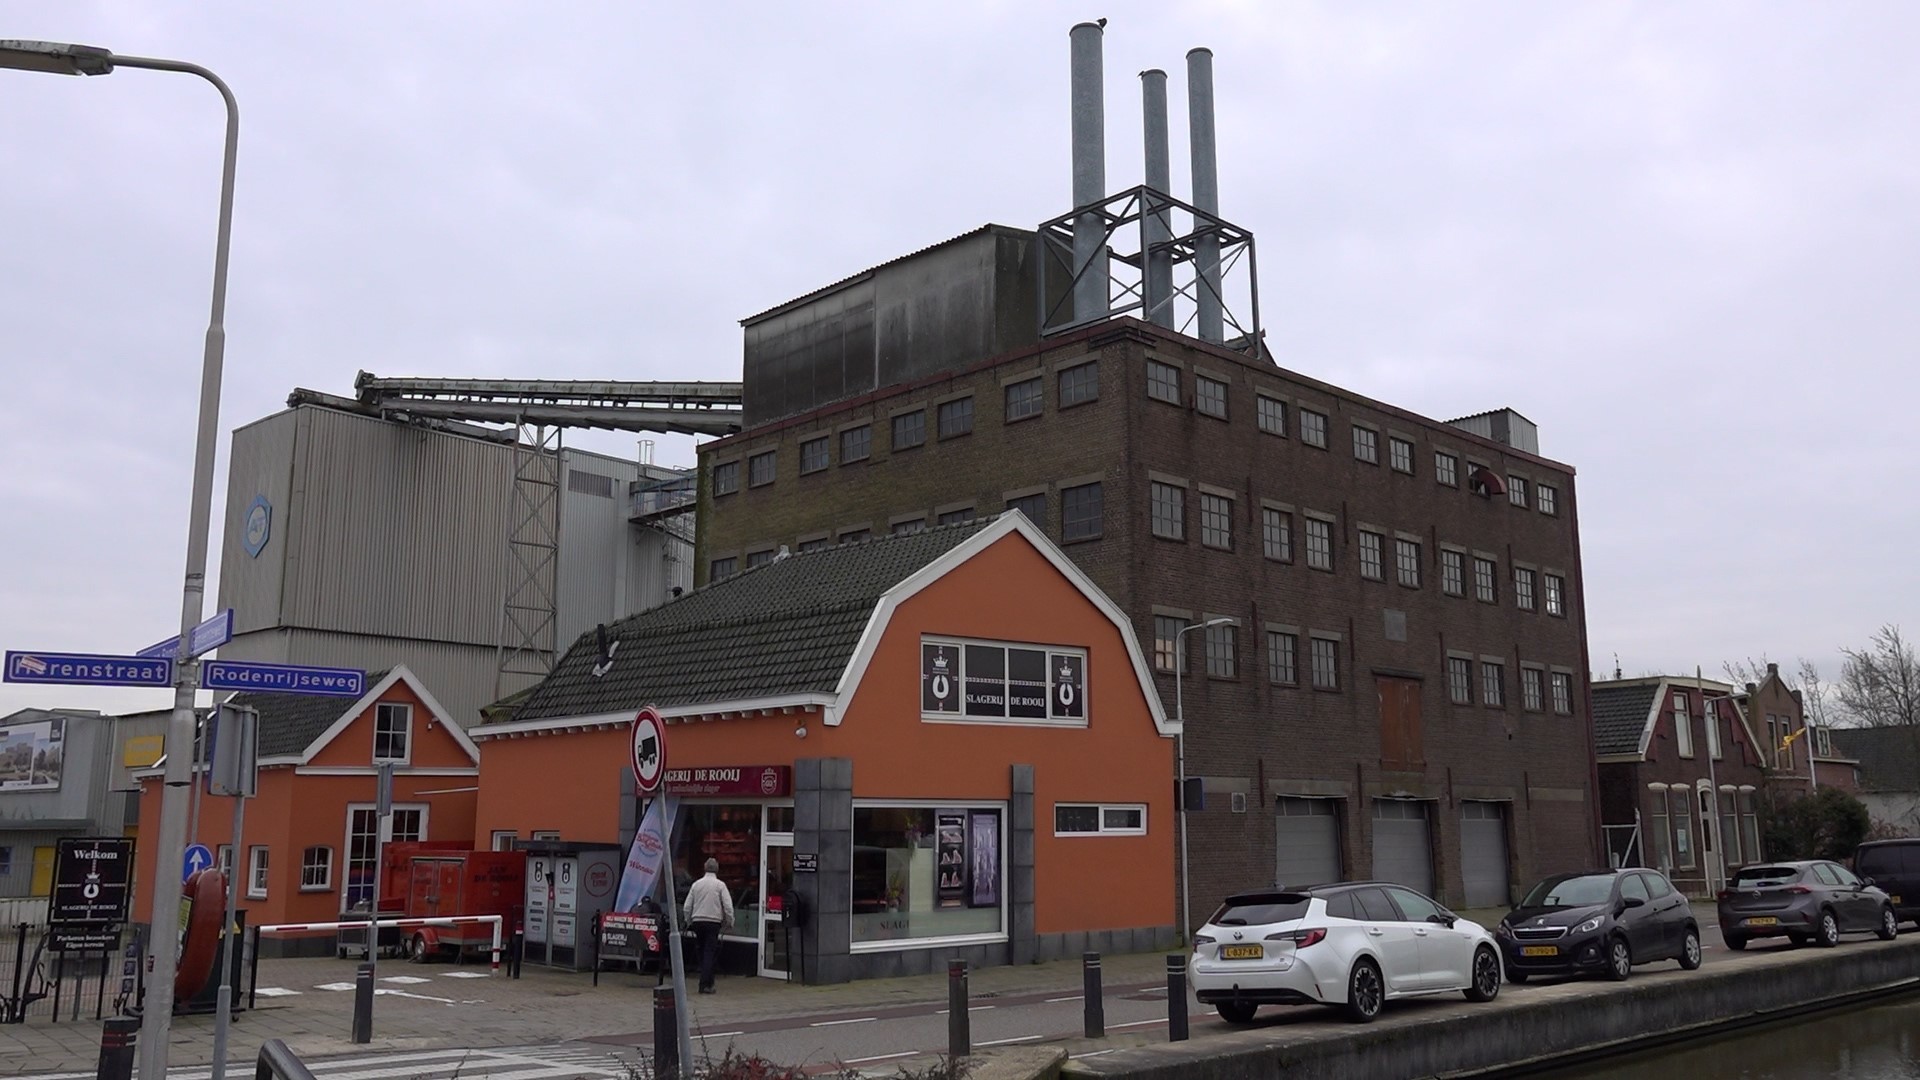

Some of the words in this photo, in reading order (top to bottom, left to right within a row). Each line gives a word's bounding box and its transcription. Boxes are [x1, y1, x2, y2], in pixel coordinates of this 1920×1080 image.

[212, 667, 357, 691] Rodenrijseweg
[966, 693, 1004, 705] SLAGERIJ
[1010, 696, 1021, 706] DE
[1021, 697, 1045, 708] ROOIJ
[694, 769, 707, 781] DE
[709, 768, 741, 782] ROOIJ
[73, 849, 118, 859] Welkom
